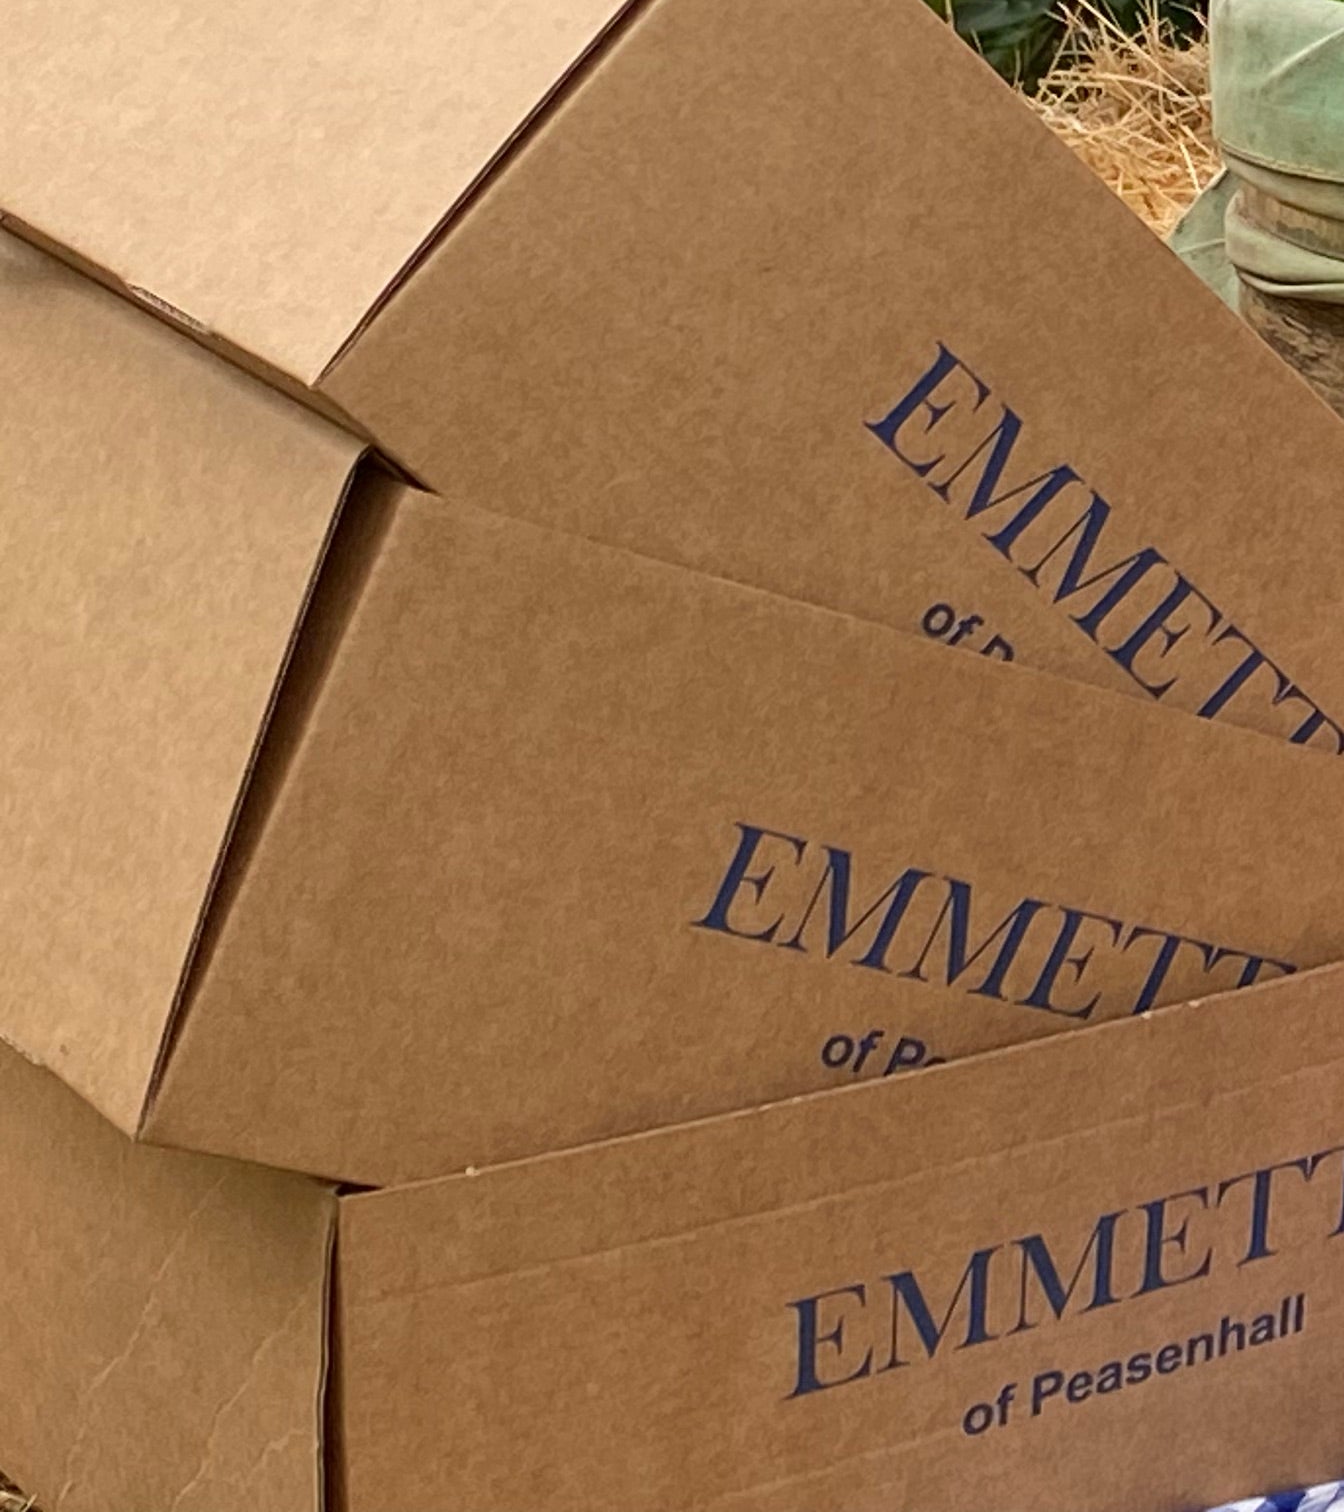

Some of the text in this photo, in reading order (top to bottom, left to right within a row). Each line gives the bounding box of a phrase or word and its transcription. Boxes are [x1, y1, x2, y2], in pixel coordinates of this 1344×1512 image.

[821, 1029, 885, 1073] of
[961, 1294, 1306, 1437] of Peasenhall
